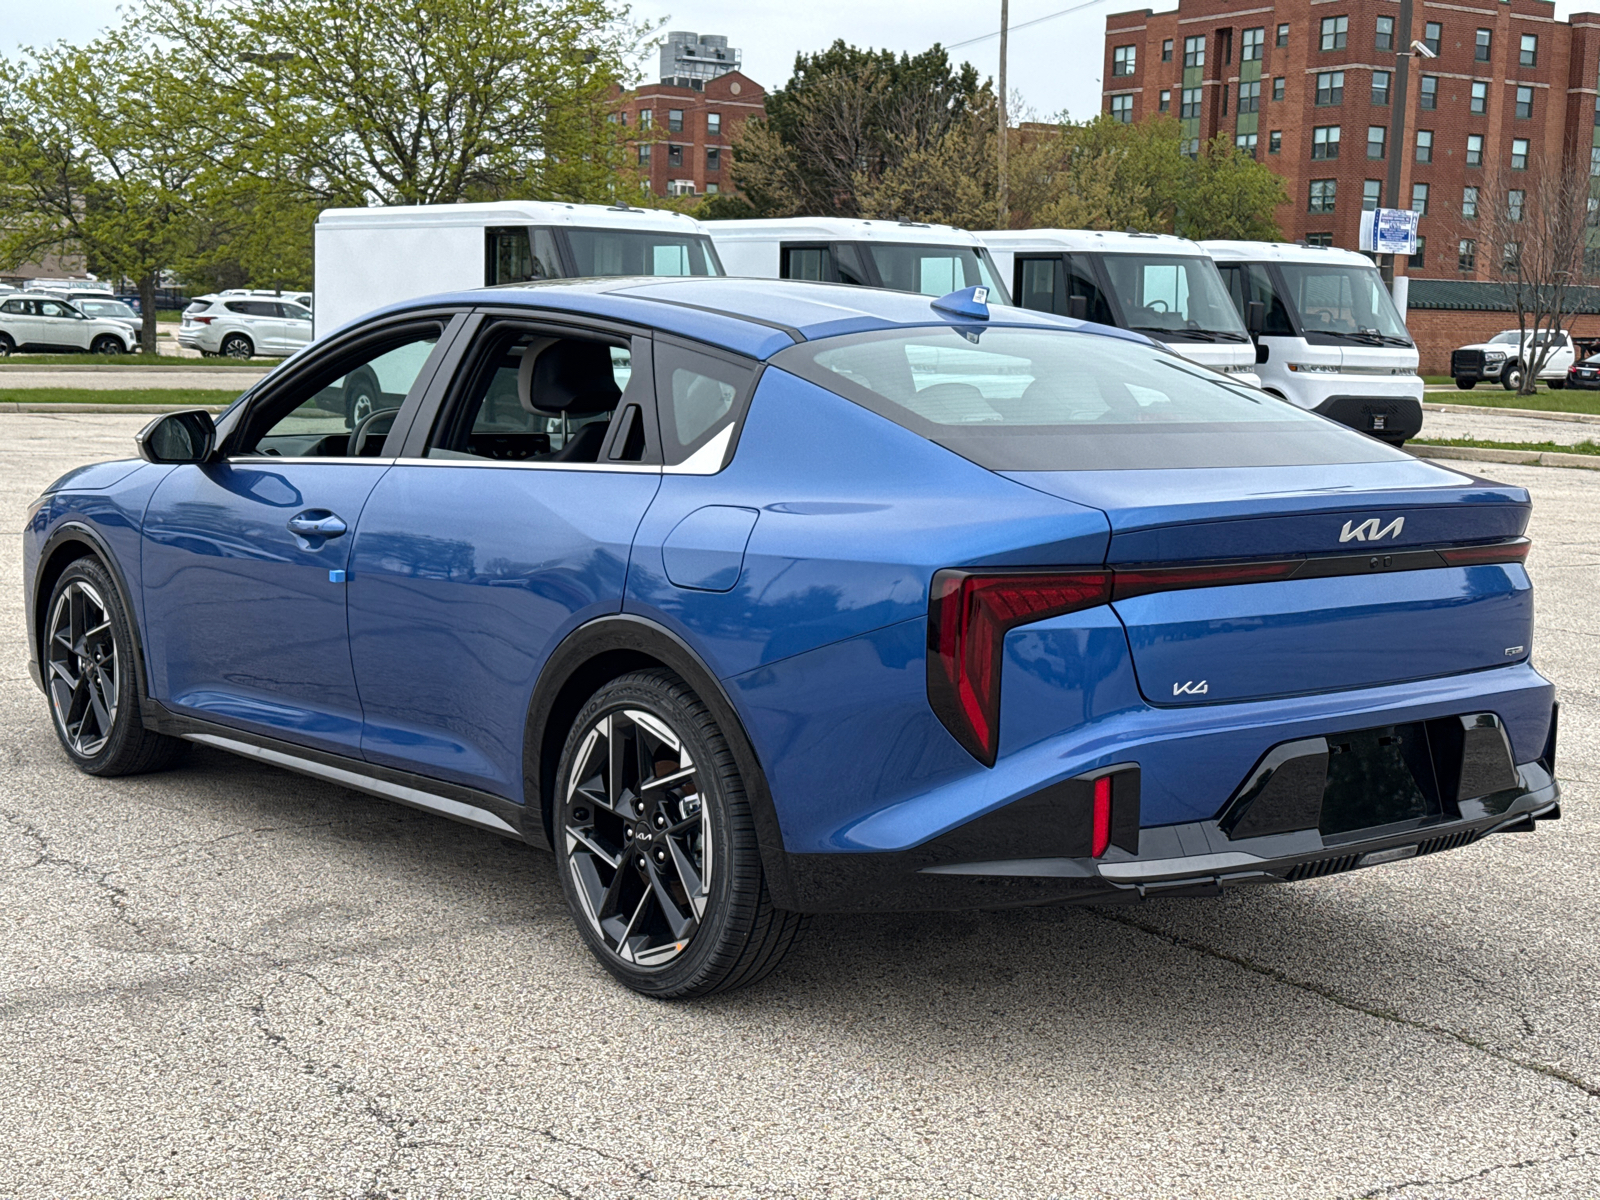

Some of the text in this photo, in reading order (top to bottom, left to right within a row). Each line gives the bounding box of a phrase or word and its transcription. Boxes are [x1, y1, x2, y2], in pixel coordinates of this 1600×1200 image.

[1339, 517, 1405, 542] KIA
[1173, 680, 1208, 696] K4
[565, 701, 598, 754] KUMHO
[635, 832, 652, 841] KIA
